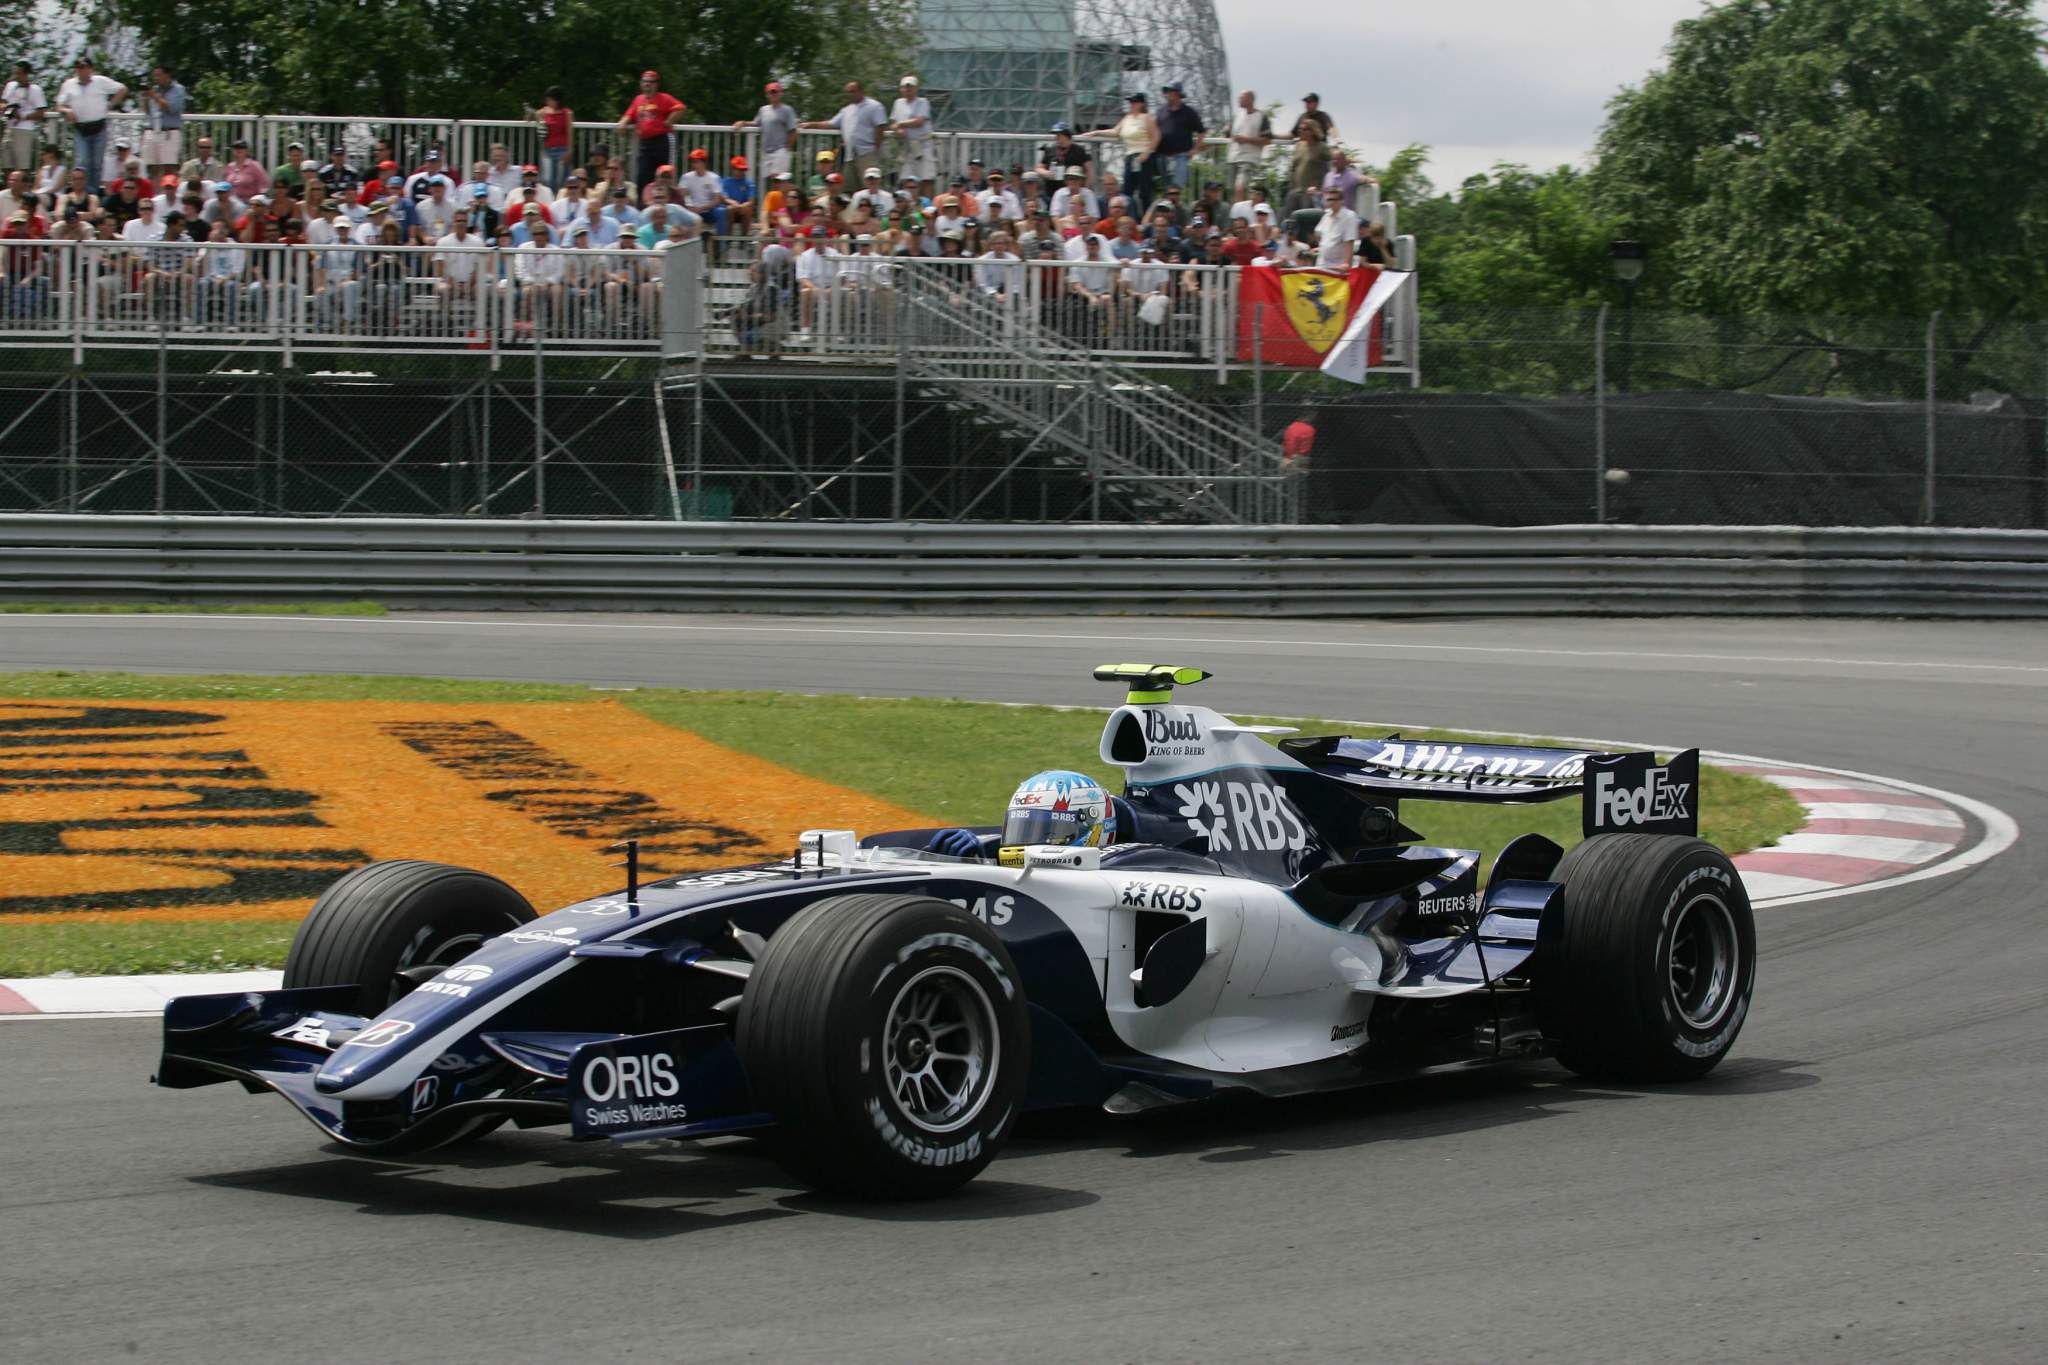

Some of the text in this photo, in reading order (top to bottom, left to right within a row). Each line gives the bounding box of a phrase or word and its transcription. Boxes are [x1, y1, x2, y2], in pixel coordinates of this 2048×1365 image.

[1142, 709, 1201, 743] Bud
[1360, 743, 1546, 788] Allianz
[1595, 767, 1690, 827] FedEx
[1227, 782, 1306, 851] RBS
[1151, 884, 1209, 913] RBS
[1418, 895, 1466, 915] REUTERS
[415, 982, 473, 998] TATA
[582, 1053, 681, 1102] ORIS
[585, 1102, 688, 1127] Swiss Watches
